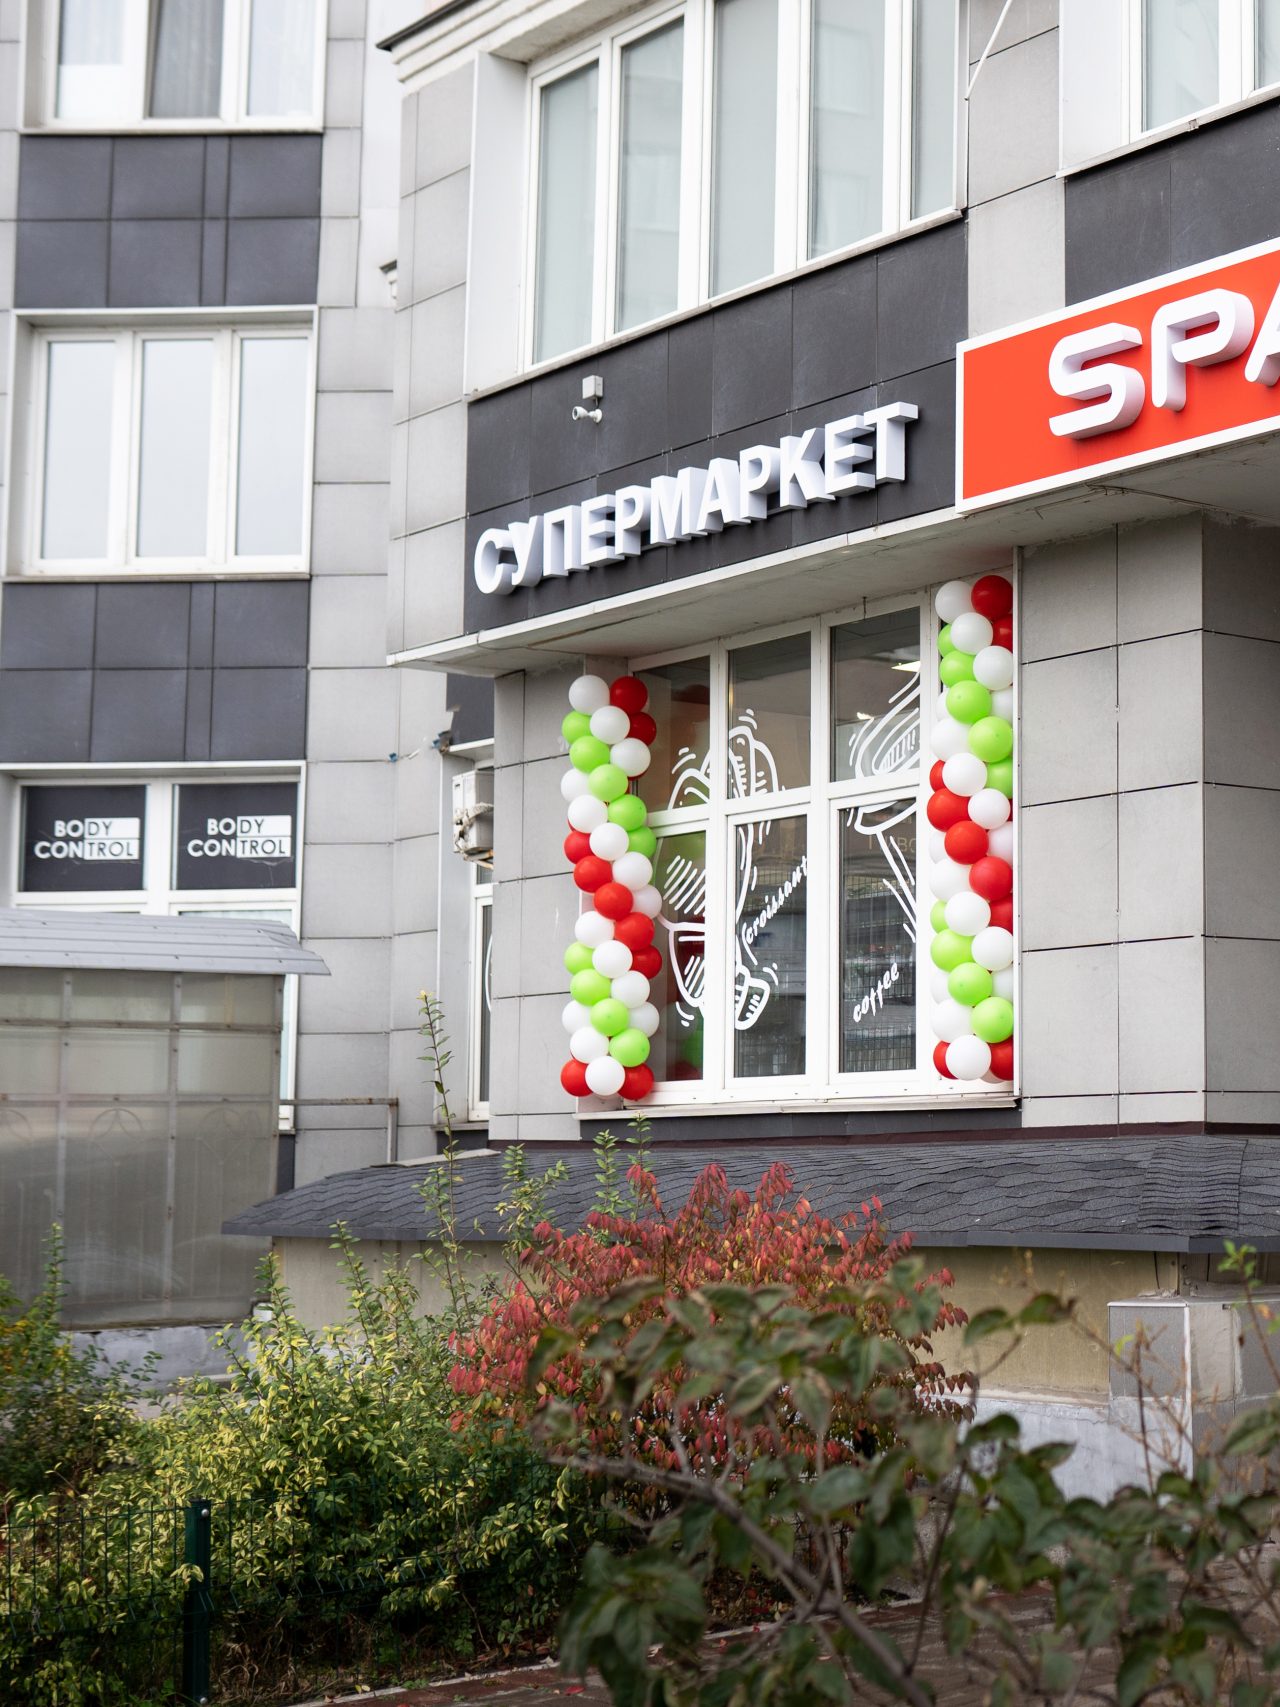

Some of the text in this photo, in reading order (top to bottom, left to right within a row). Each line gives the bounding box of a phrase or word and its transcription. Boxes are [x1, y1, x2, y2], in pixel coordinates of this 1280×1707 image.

[473, 401, 919, 595] СУПЕРМАРКЕТ
[54, 819, 114, 838] BODY
[206, 817, 266, 836] BODY
[34, 840, 134, 859] CONTROL
[187, 838, 287, 857] CONTROL
[746, 855, 807, 945] croissant
[853, 962, 900, 1023] coffee
